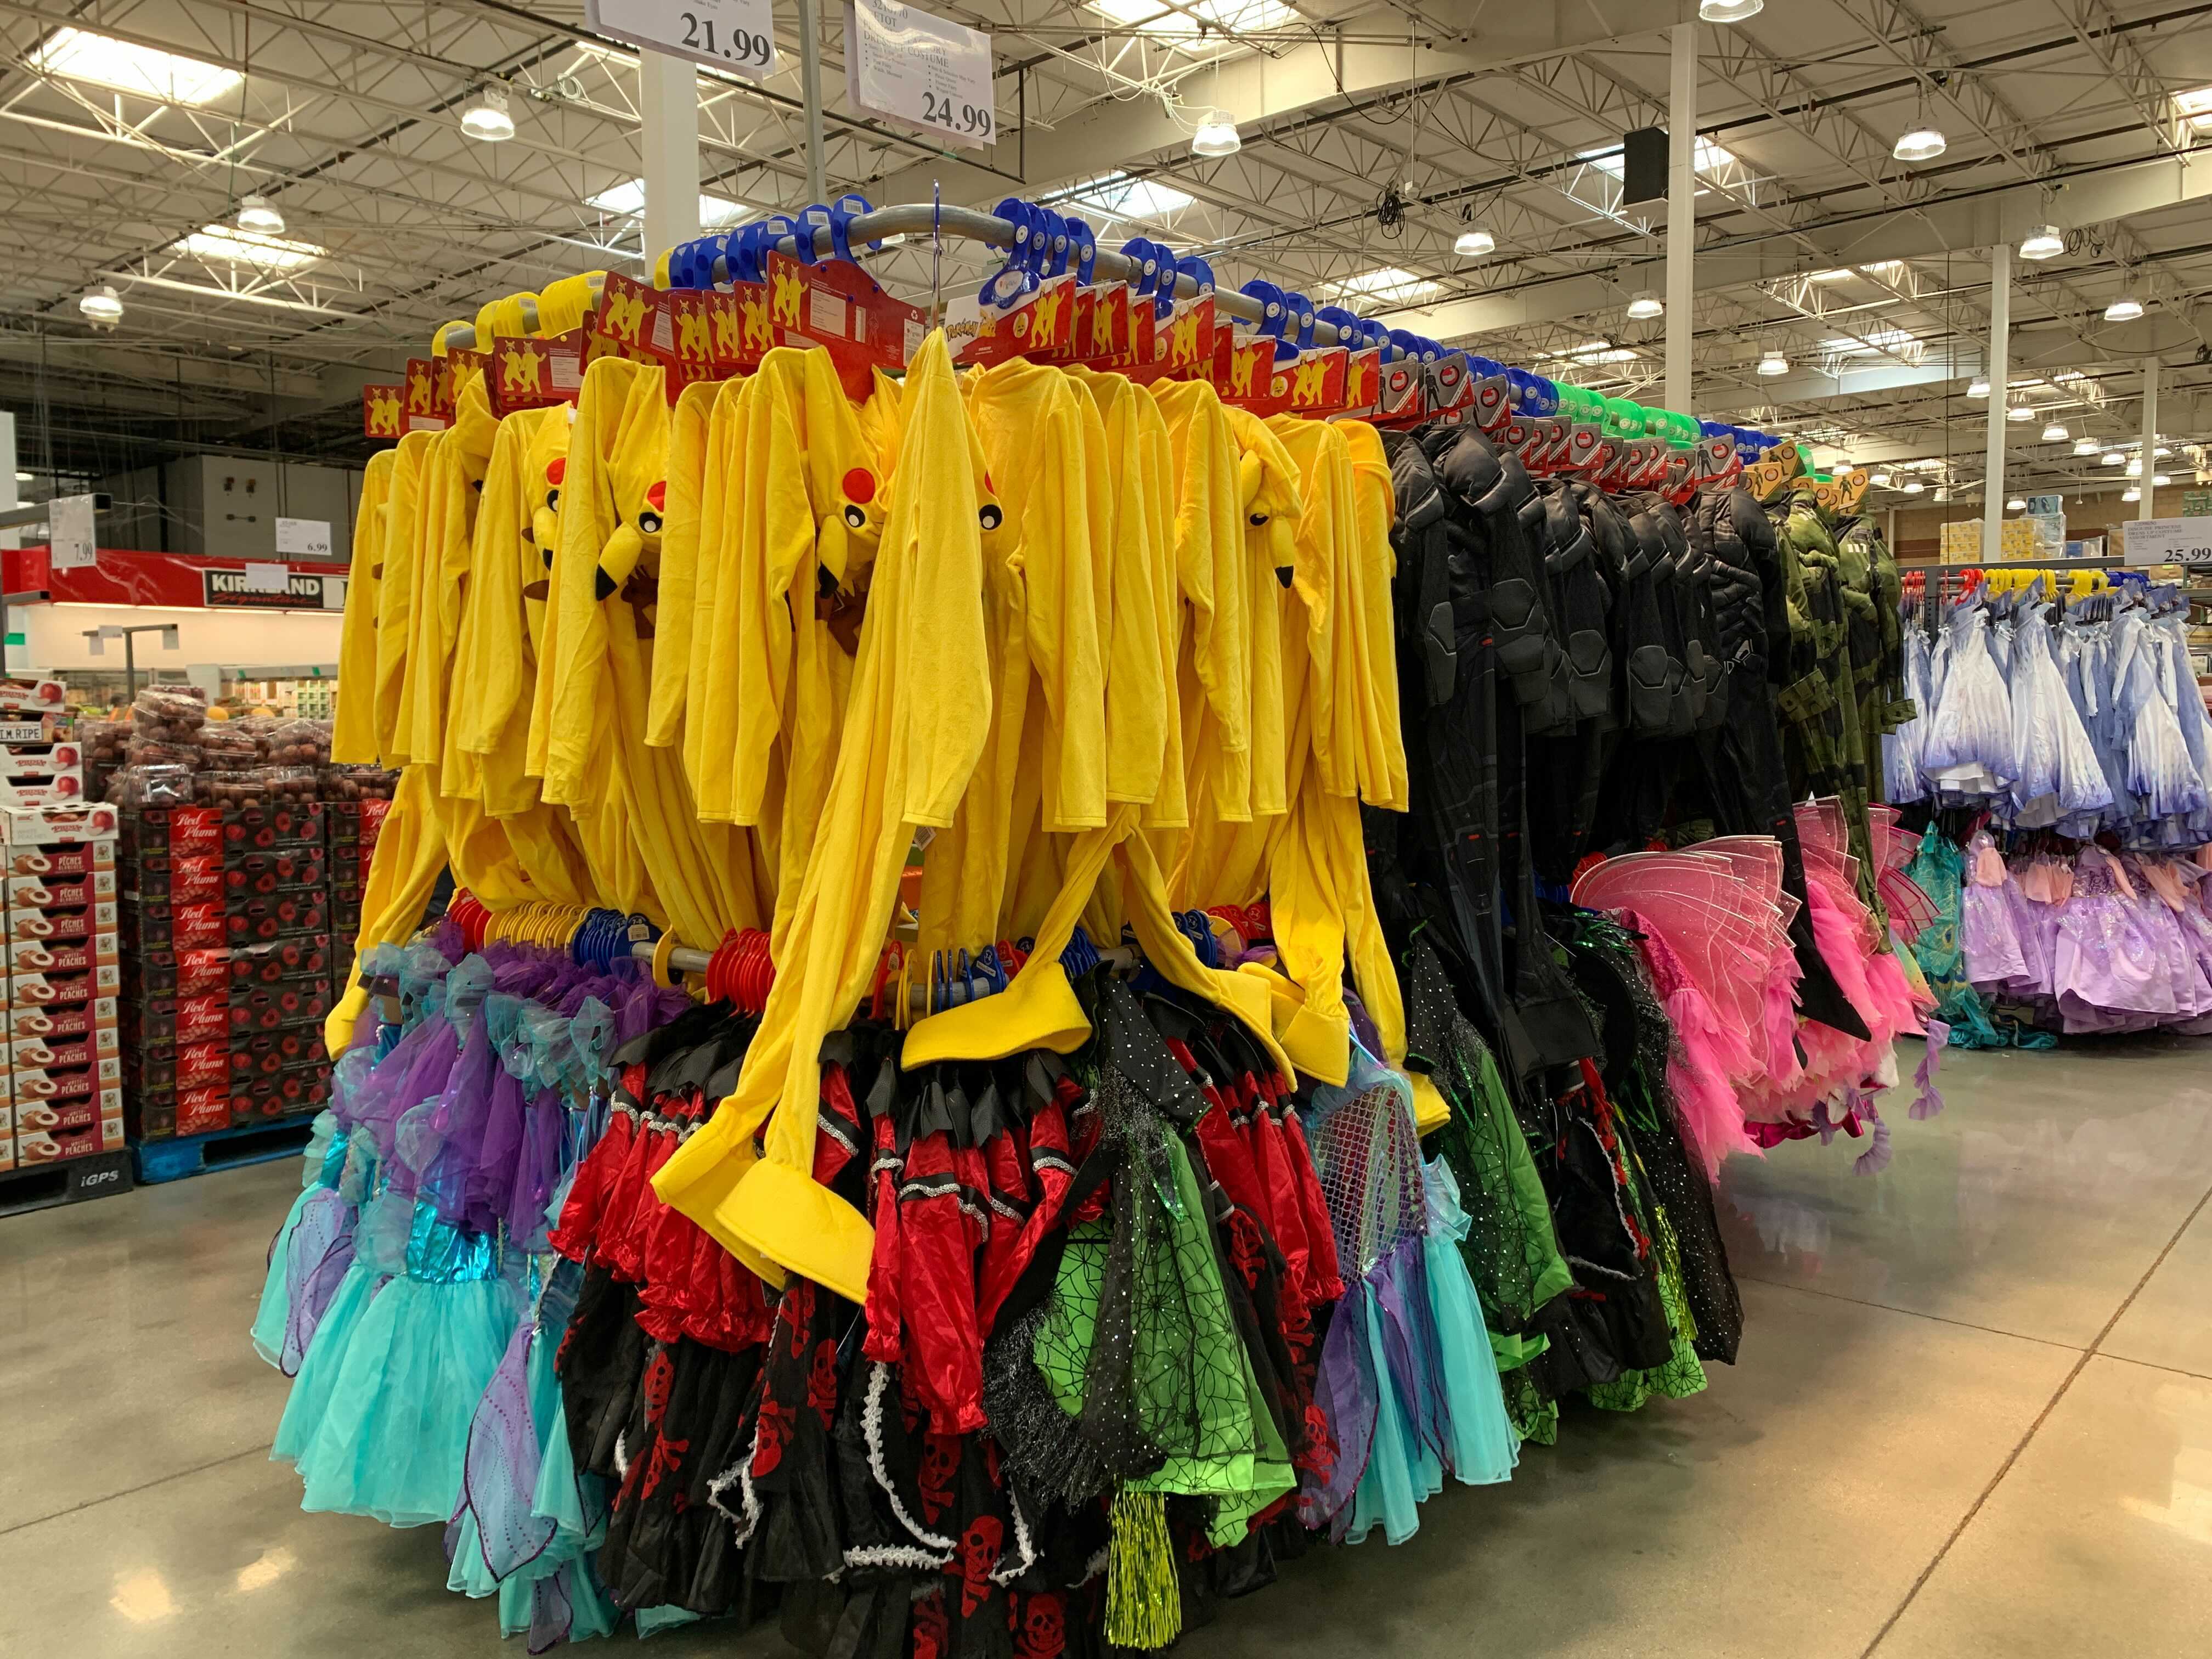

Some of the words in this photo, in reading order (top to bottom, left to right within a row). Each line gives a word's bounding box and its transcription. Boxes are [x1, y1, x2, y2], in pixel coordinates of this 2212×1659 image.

[681, 13, 770, 66] 21.99
[908, 46, 949, 67] COSTUME
[922, 92, 991, 137] 24.99
[74, 541, 93, 561] 7.99
[307, 543, 328, 551] 6.99
[1847, 543, 1867, 554] 117
[2164, 548, 2212, 562] 25.99
[212, 574, 320, 595] KIRND
[15, 728, 40, 739] RIPE
[176, 811, 208, 826] Red
[182, 824, 218, 838] Plums
[177, 858, 208, 874] Red
[183, 871, 219, 885] Plums
[179, 904, 210, 920] Red
[185, 917, 221, 932] Plums
[58, 956, 87, 968] PEACHES
[183, 951, 210, 967] Red
[190, 963, 225, 978] Plums
[59, 989, 88, 1000] PEACHES
[182, 996, 213, 1014] Red
[188, 1010, 224, 1026] Plums
[57, 1021, 86, 1032] PEACHES
[59, 1052, 87, 1064] PEACHES
[183, 1043, 211, 1060] Red
[189, 1056, 224, 1071] Plums
[61, 1082, 89, 1094] PEACHES
[182, 1087, 211, 1105] Red
[189, 1099, 224, 1116] Plums
[63, 1113, 91, 1125] PEACHES
[65, 1143, 93, 1155] PEACHES
[80, 1170, 119, 1188] iGPS
